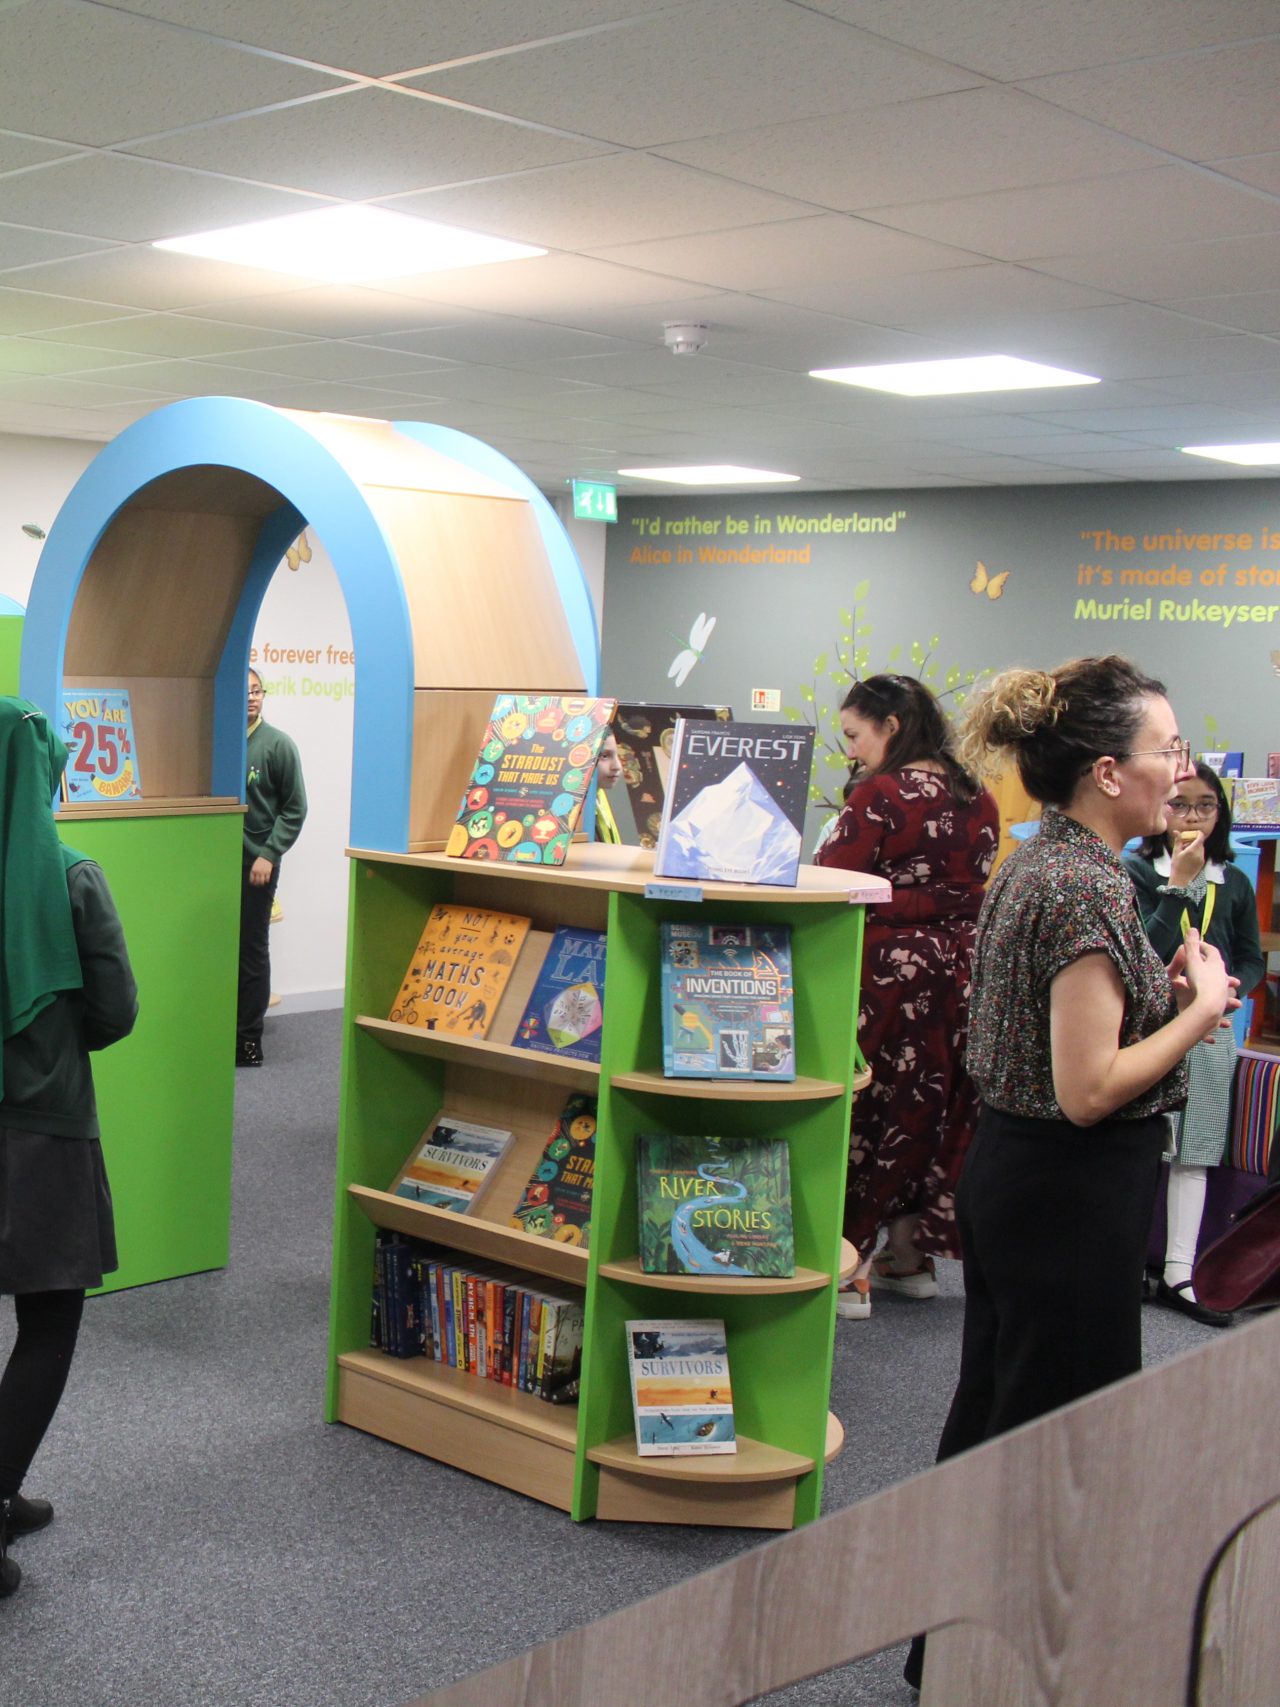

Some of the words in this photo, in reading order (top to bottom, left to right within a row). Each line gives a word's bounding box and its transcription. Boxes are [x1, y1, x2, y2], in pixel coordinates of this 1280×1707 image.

[665, 515, 721, 535] rather
[725, 514, 749, 534] be
[754, 514, 771, 533] in
[776, 510, 907, 534] Wonderland"
[1080, 528, 1136, 551] "The
[1143, 528, 1253, 551] universe
[630, 544, 671, 565] Alice
[676, 544, 693, 564] in
[698, 543, 811, 565] Wonderland
[1077, 563, 1113, 587] it's
[1120, 564, 1193, 587] made
[1200, 563, 1228, 586] of
[1074, 598, 1152, 620] Muriel
[1158, 598, 1279, 628] Rukeyser
[264, 643, 321, 664] forever
[64, 699, 99, 719] YOU
[103, 708, 128, 723] ARE
[73, 721, 131, 775] 25%
[687, 735, 806, 761] EVEREST
[501, 754, 567, 772] STARDUST
[99, 770, 132, 796] BANANA
[497, 770, 520, 783] THAT
[520, 772, 545, 785] MADE
[545, 773, 560, 786] US
[464, 913, 493, 928] NOT
[455, 933, 478, 944] your
[560, 939, 607, 961] MAT
[440, 946, 484, 963] average
[423, 960, 486, 987] MATHS
[550, 954, 605, 986] LA
[422, 983, 469, 1008] BOOK
[686, 978, 777, 996] INVENTIONS
[424, 1147, 489, 1171] SURVIVORS
[561, 1171, 584, 1185] THAT
[660, 1176, 721, 1199] RIVER
[692, 1208, 771, 1232] STORIES
[641, 1360, 723, 1376] SURVIVORS
